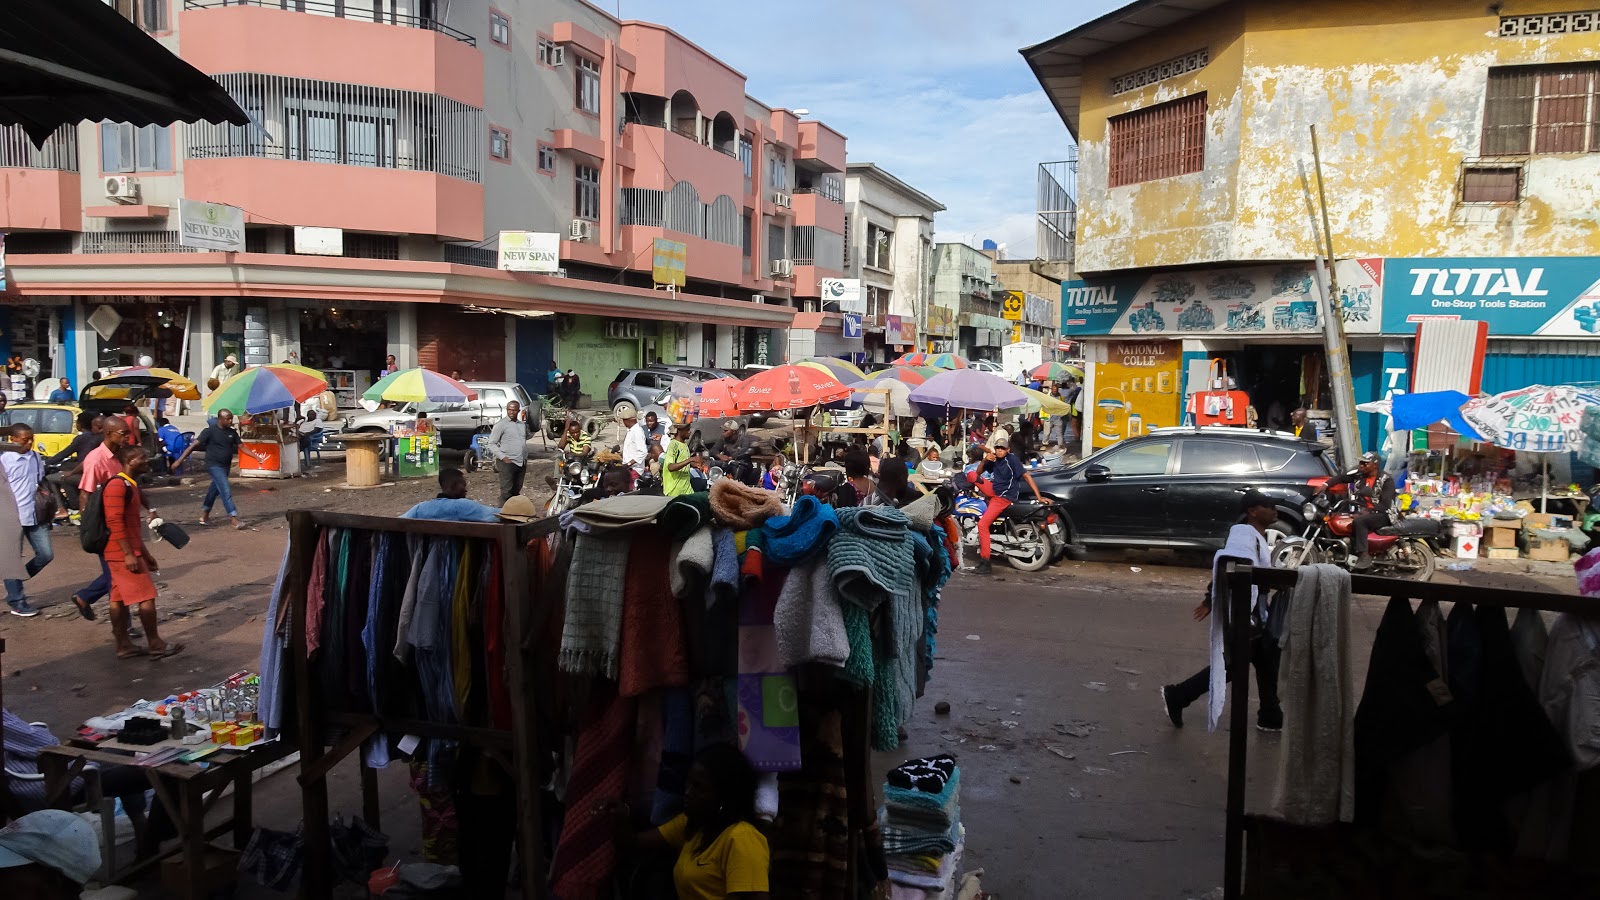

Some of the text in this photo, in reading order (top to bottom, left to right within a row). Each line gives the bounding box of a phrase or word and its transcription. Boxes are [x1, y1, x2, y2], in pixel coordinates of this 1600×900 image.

[184, 222, 209, 236] NEW
[212, 226, 240, 239] SPAN
[504, 251, 555, 261] NEW SPAN
[1362, 261, 1380, 280] TOTAL
[1409, 268, 1549, 296] TOTAL
[1067, 286, 1118, 307] TOTAL
[1431, 299, 1546, 309] One-Stop Tools Station
[1117, 344, 1165, 355] NATIONAL
[1123, 355, 1156, 366] COLLE
[748, 386, 772, 394] Buvez
[813, 381, 836, 391] Buvez
